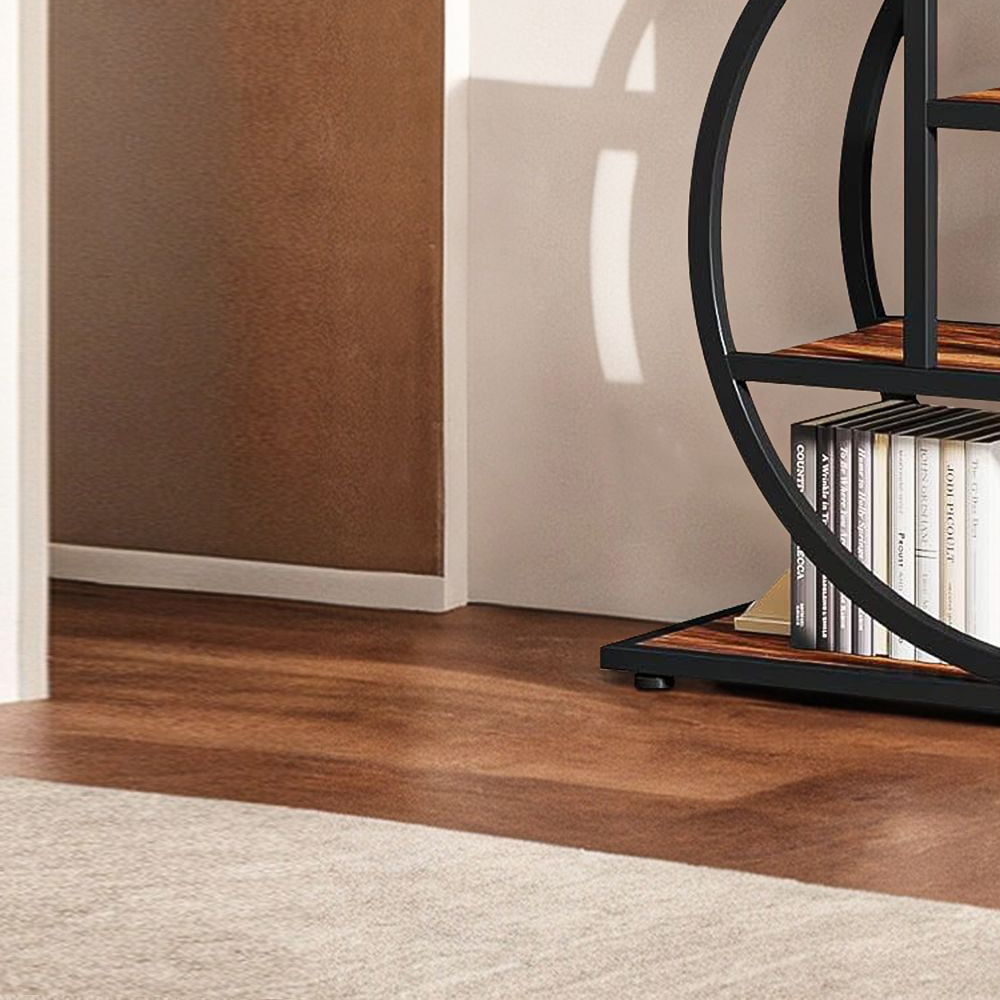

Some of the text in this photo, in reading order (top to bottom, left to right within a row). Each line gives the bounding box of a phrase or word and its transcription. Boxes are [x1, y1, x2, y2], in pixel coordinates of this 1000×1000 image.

[822, 453, 829, 462] A
[822, 463, 830, 499] Wrinkle
[822, 501, 829, 511] in
[946, 464, 955, 563] JODI PICOULT
[797, 545, 805, 580] ECCA
